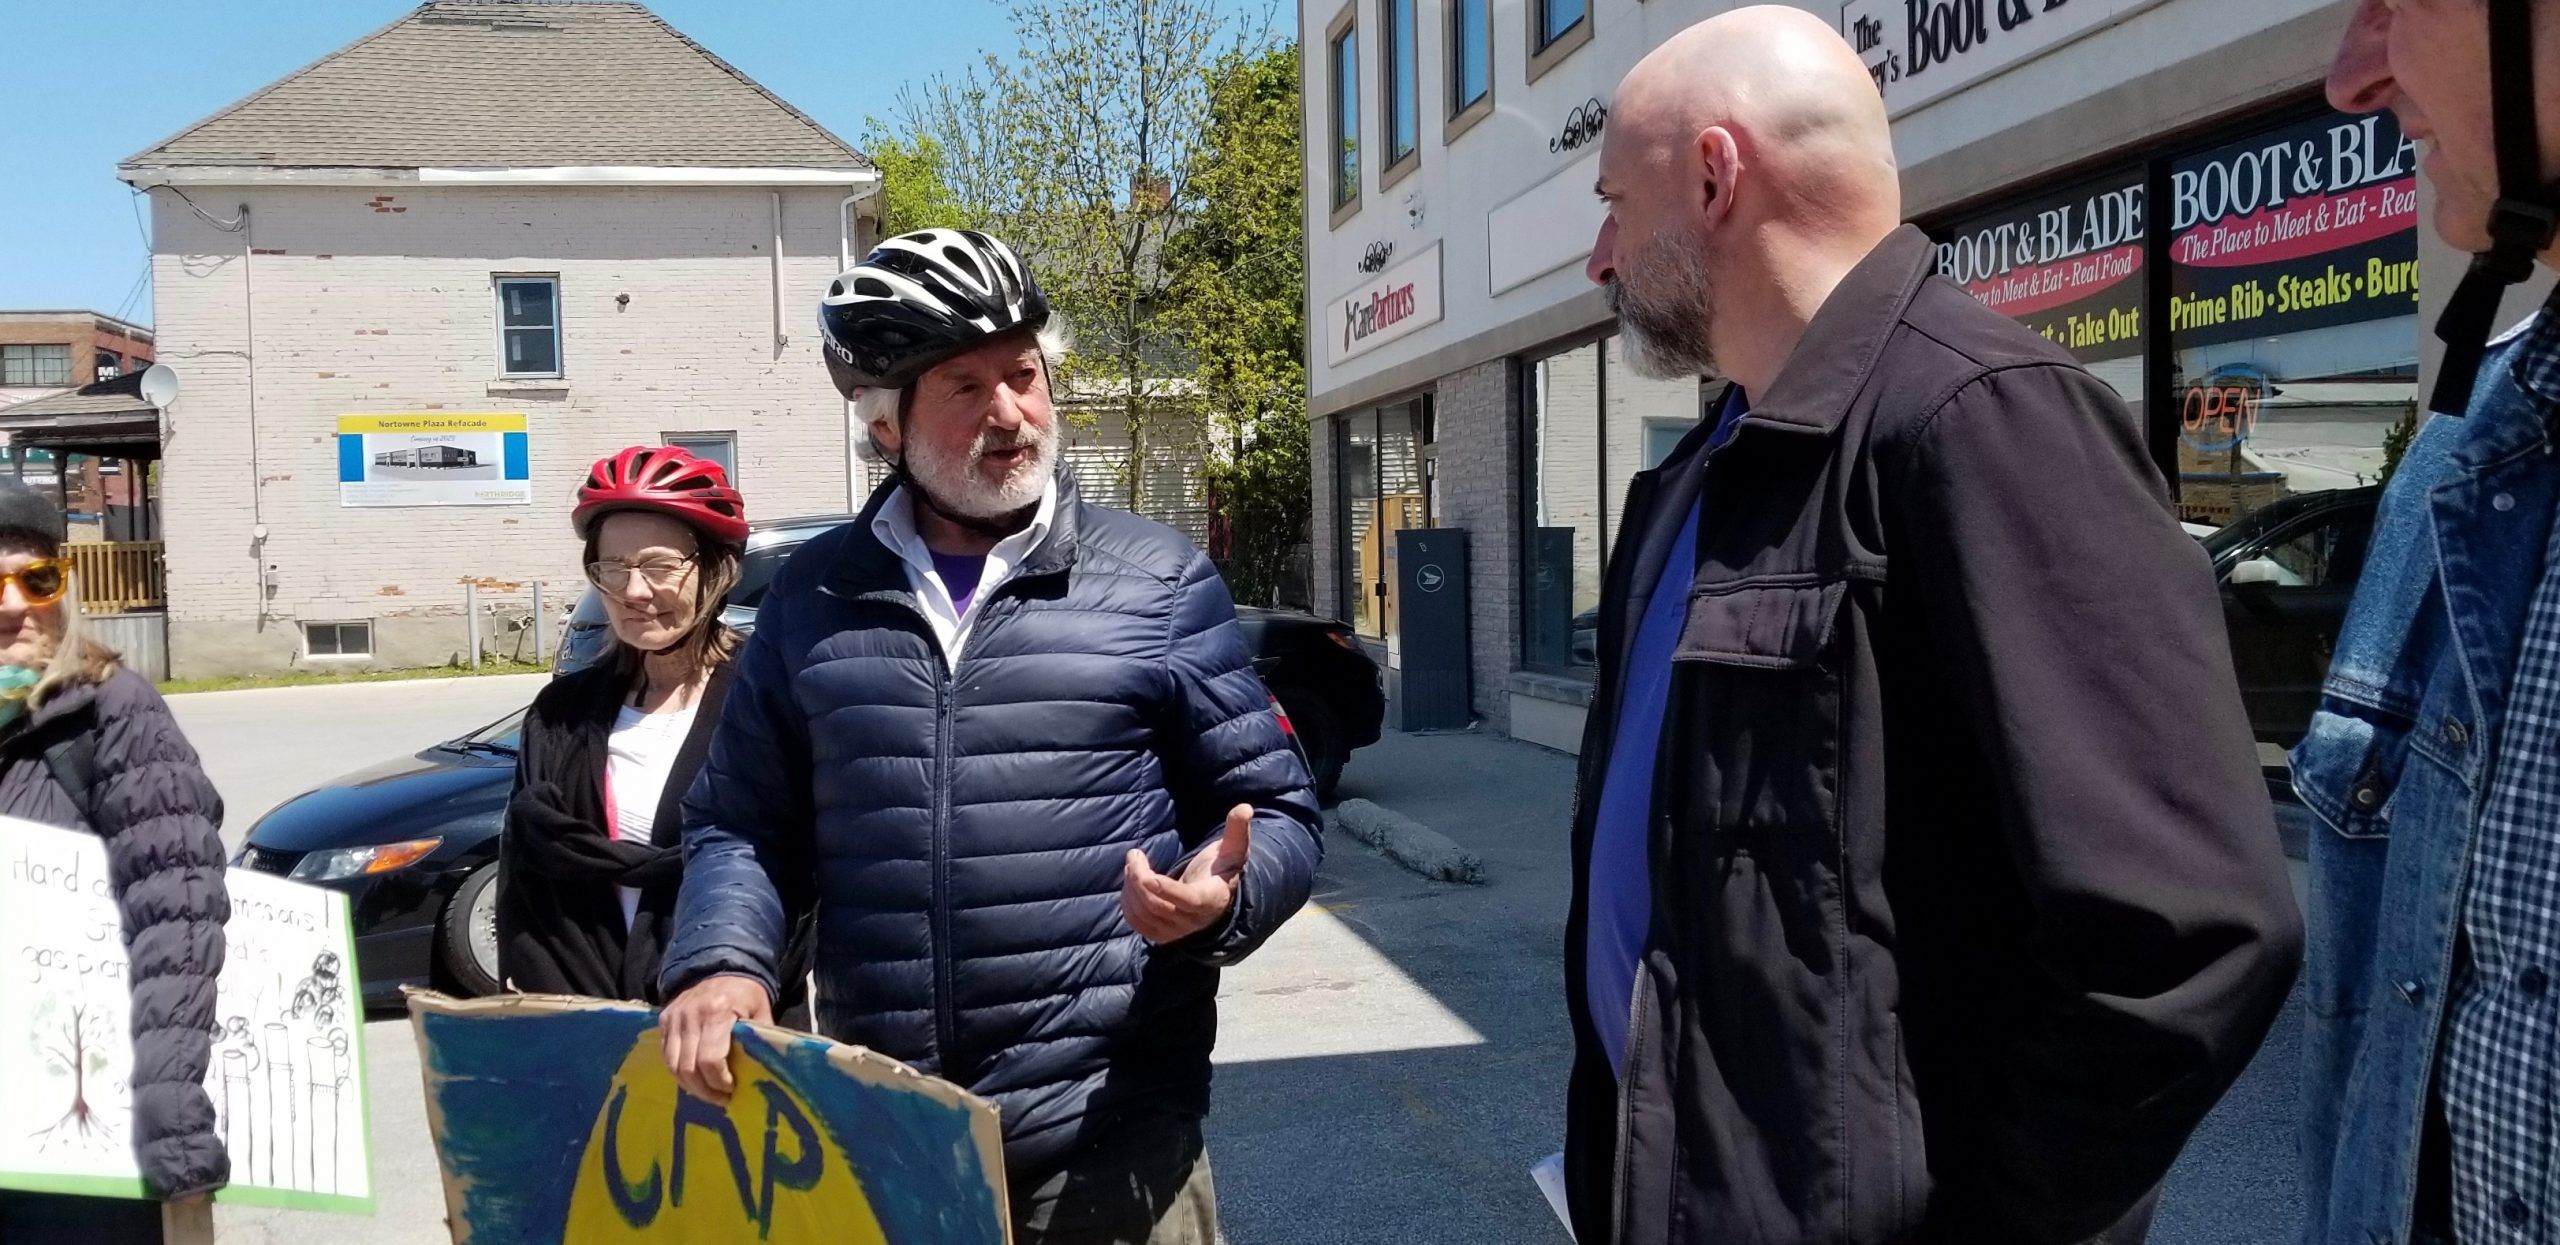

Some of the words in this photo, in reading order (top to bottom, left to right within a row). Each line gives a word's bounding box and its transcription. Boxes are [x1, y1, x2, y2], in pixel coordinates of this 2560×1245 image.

[1853, 14, 1881, 54] The
[1867, 49, 1900, 98] ey's
[2171, 141, 2292, 231] BOOT
[1937, 222, 2015, 285] BOOT
[2038, 183, 2144, 264] BLADE
[2181, 236, 2208, 263] The
[2210, 226, 2251, 257] Place
[2254, 221, 2269, 246] to
[2271, 210, 2312, 243] Meet
[2314, 203, 2330, 232] &
[2333, 195, 2366, 229] Eat
[1991, 285, 2001, 307] to
[2001, 277, 2028, 304] Meet
[2029, 272, 2040, 297] &
[2042, 268, 2063, 294] Eat
[2071, 261, 2099, 287] Real
[2101, 248, 2133, 280] Food
[2170, 291, 2226, 332] Prime
[2231, 280, 2264, 321] Rib
[2277, 265, 2351, 313] Steaks
[2068, 312, 2105, 349] Take
[2108, 306, 2139, 342] Out
[378, 420, 420, 428] Nortowne
[423, 420, 445, 428] Plaza
[448, 419, 487, 427] Refacade
[2184, 386, 2261, 434] OPEN
[13, 844, 80, 893] Hard
